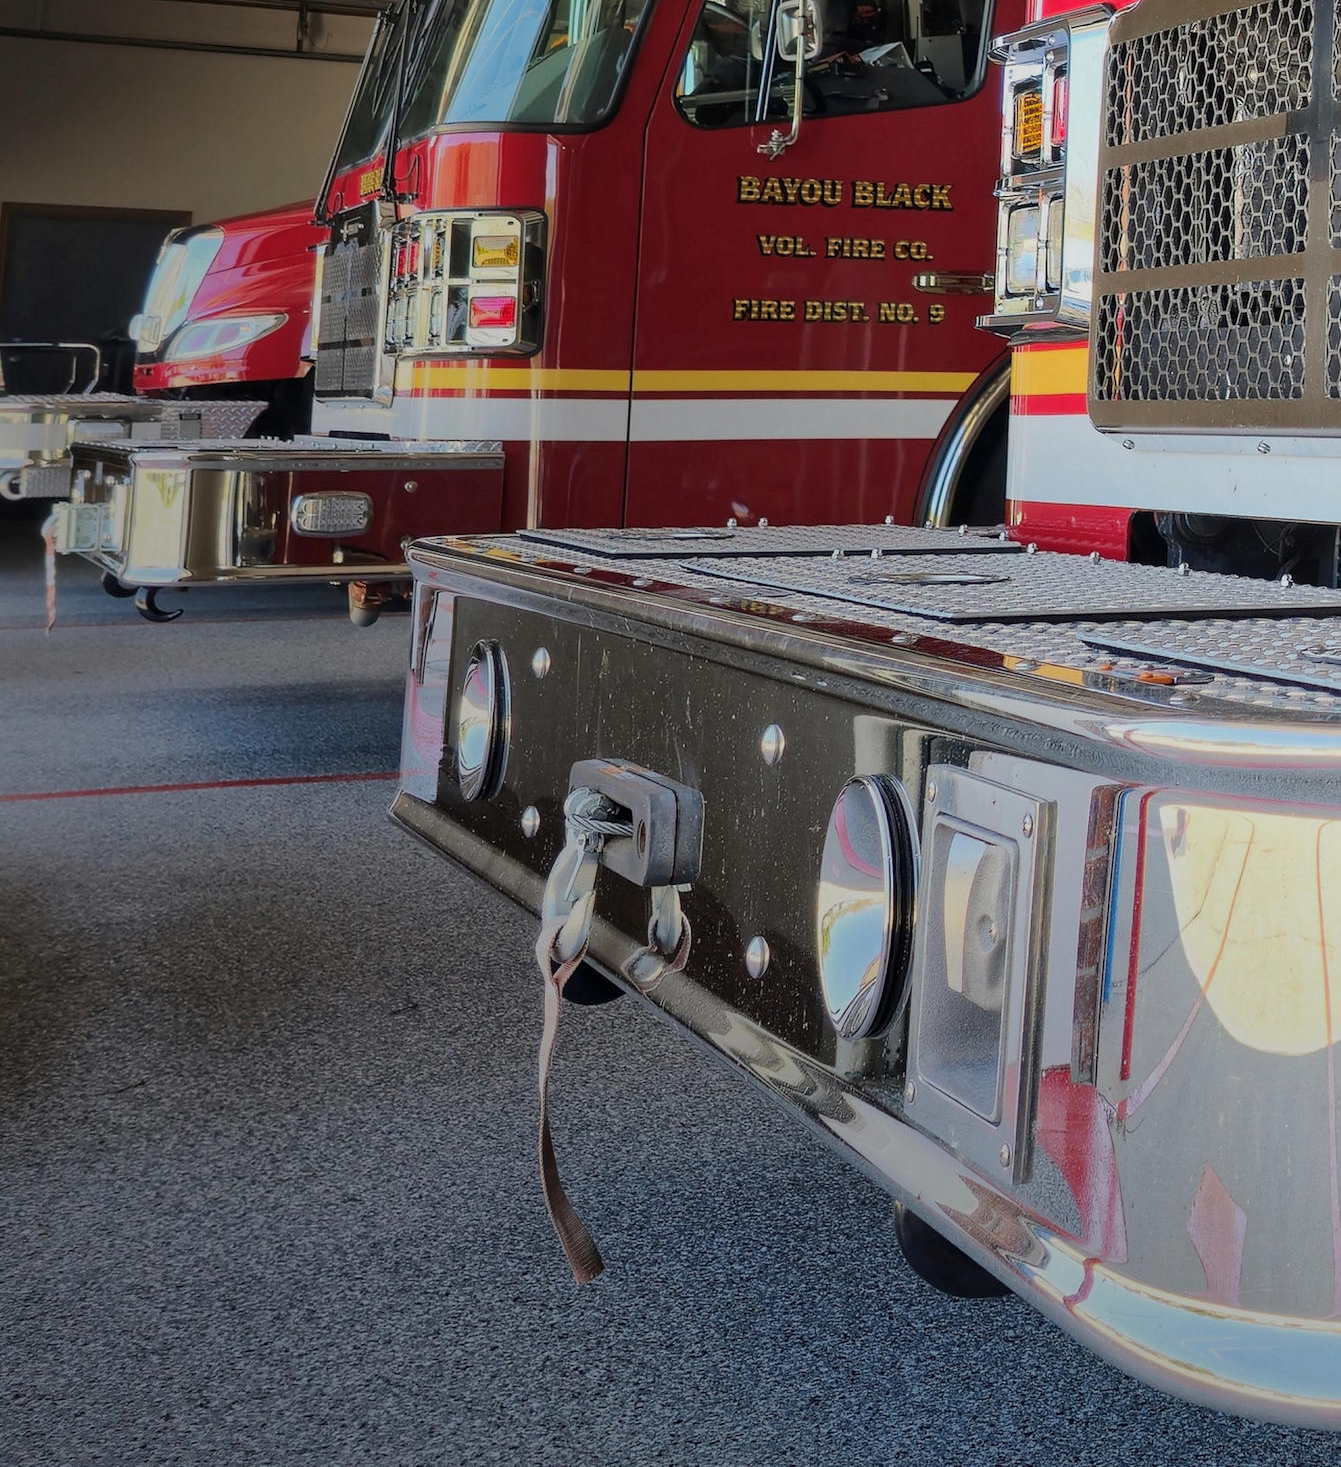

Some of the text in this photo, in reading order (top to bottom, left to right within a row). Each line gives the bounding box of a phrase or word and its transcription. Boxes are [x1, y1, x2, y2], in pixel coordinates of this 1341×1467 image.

[737, 175, 954, 212] BAYOU BLACK
[758, 234, 934, 261] VOL. FIRE CO.
[733, 298, 946, 325] FIRE DIST. NO. 9
